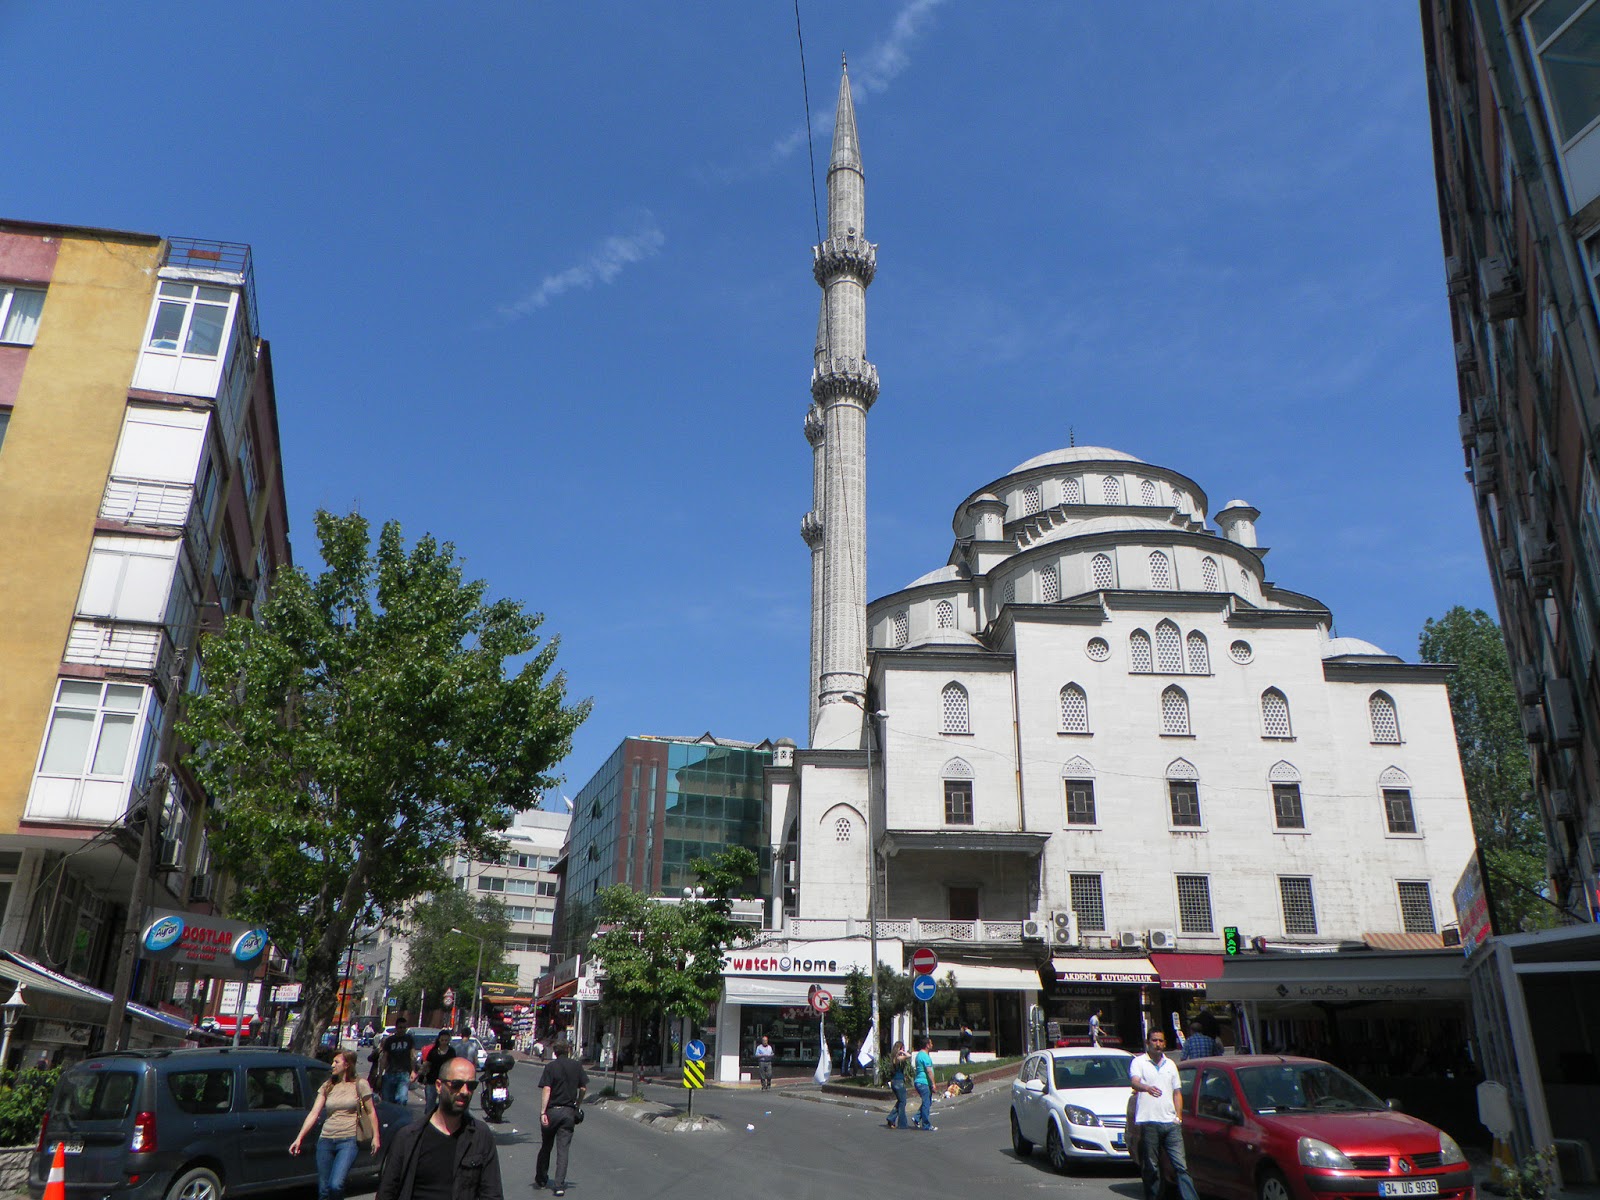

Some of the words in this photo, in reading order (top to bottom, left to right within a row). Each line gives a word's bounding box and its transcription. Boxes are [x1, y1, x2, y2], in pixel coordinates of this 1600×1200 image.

[182, 925, 233, 945] DOSTLAR
[733, 956, 778, 972] watch
[793, 956, 837, 972] home
[1063, 972, 1097, 981] AKDENİZ
[1101, 974, 1152, 982] KUYUMCULUK
[1054, 986, 1113, 995] KUYUMCUSU
[1173, 981, 1195, 989] ESİN
[390, 1040, 409, 1051] GAP
[1385, 1182, 1397, 1194] 34
[1401, 1182, 1414, 1194] UG
[1415, 1181, 1437, 1193] 9839
